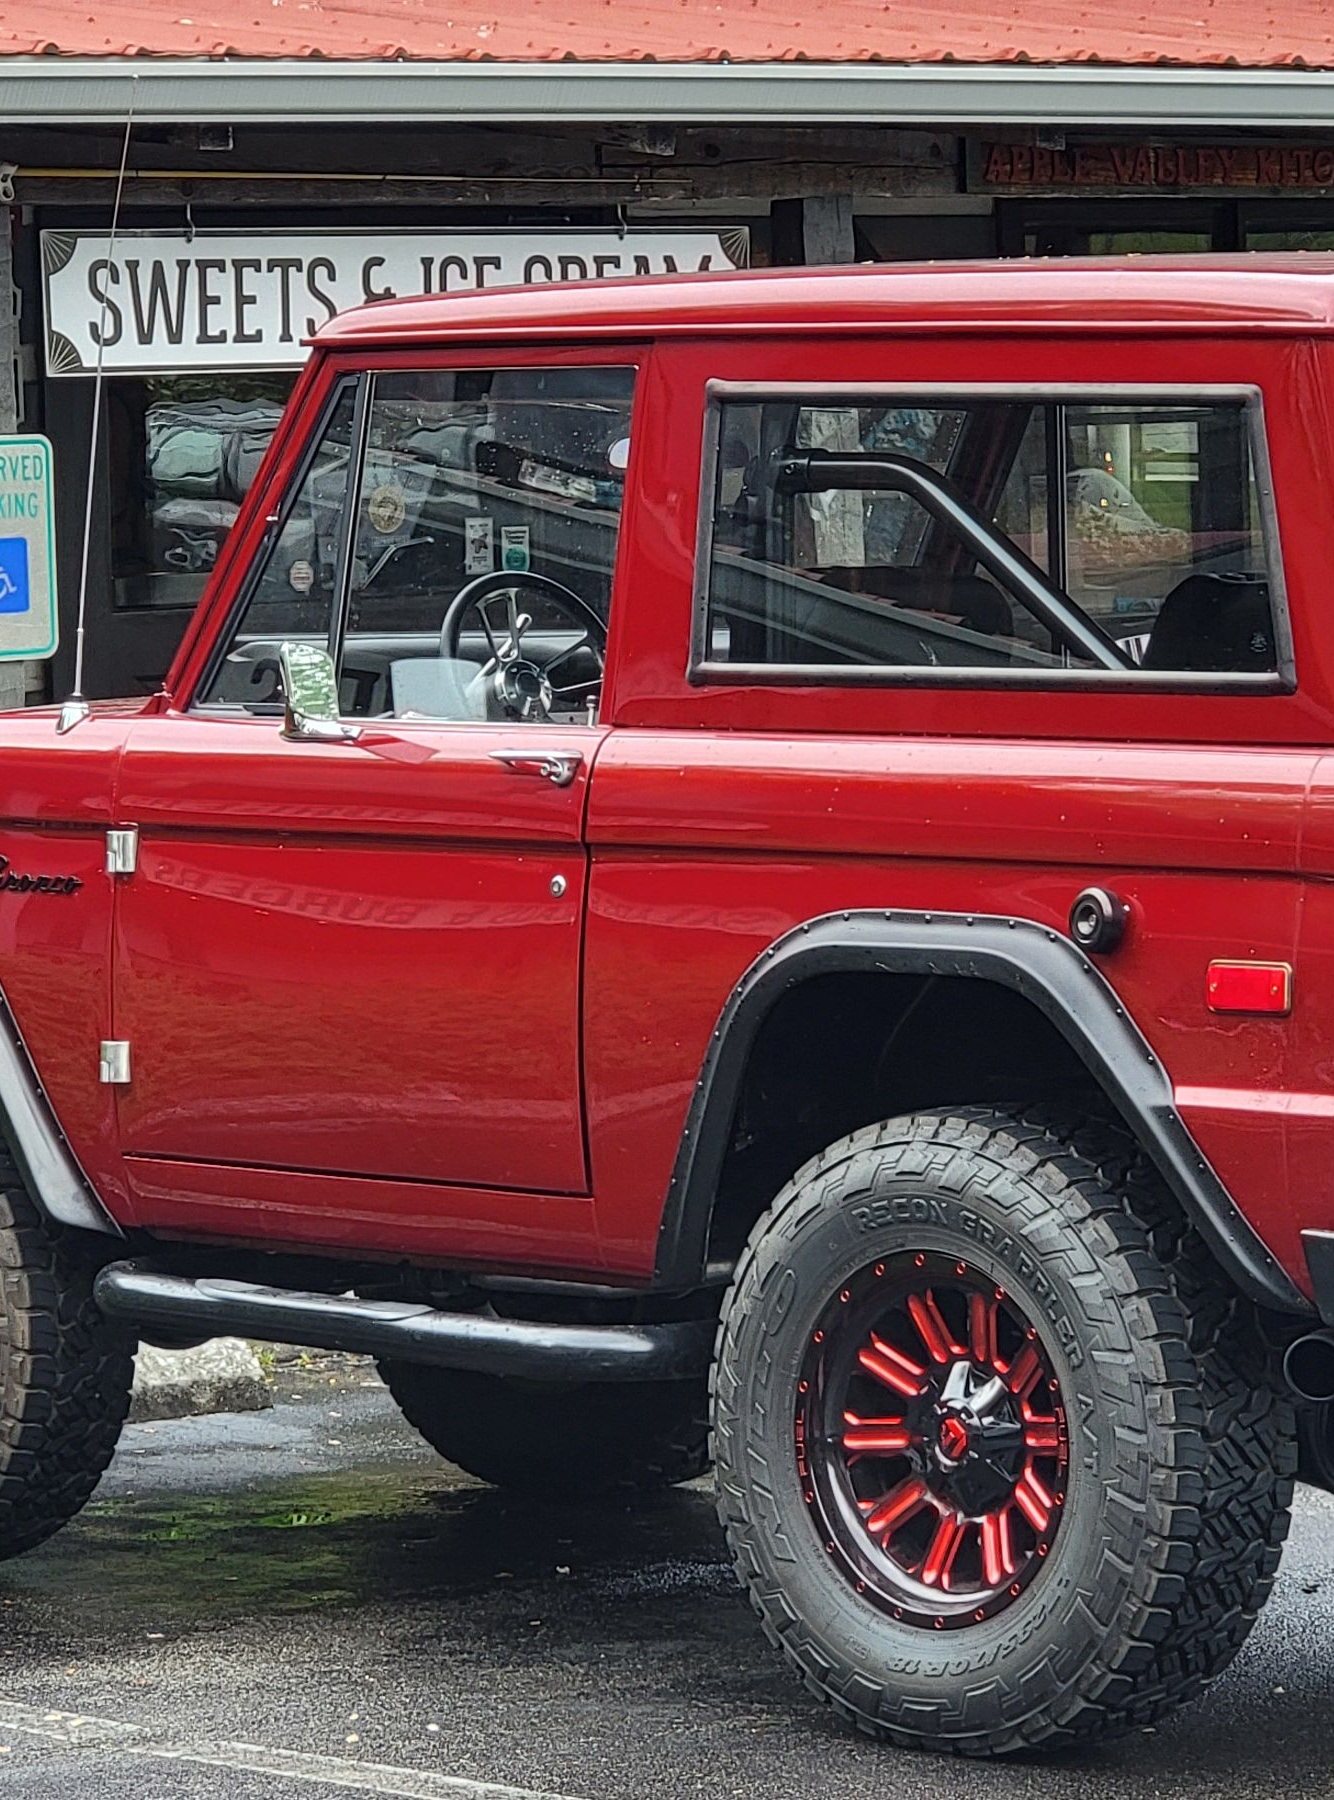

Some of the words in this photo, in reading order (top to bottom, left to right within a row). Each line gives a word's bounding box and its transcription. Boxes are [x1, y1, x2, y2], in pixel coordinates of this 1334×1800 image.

[984, 143, 1091, 181] APPLE
[1111, 147, 1240, 184] VALLEY
[88, 256, 336, 346] SWEETS
[851, 1198, 948, 1233] RECON
